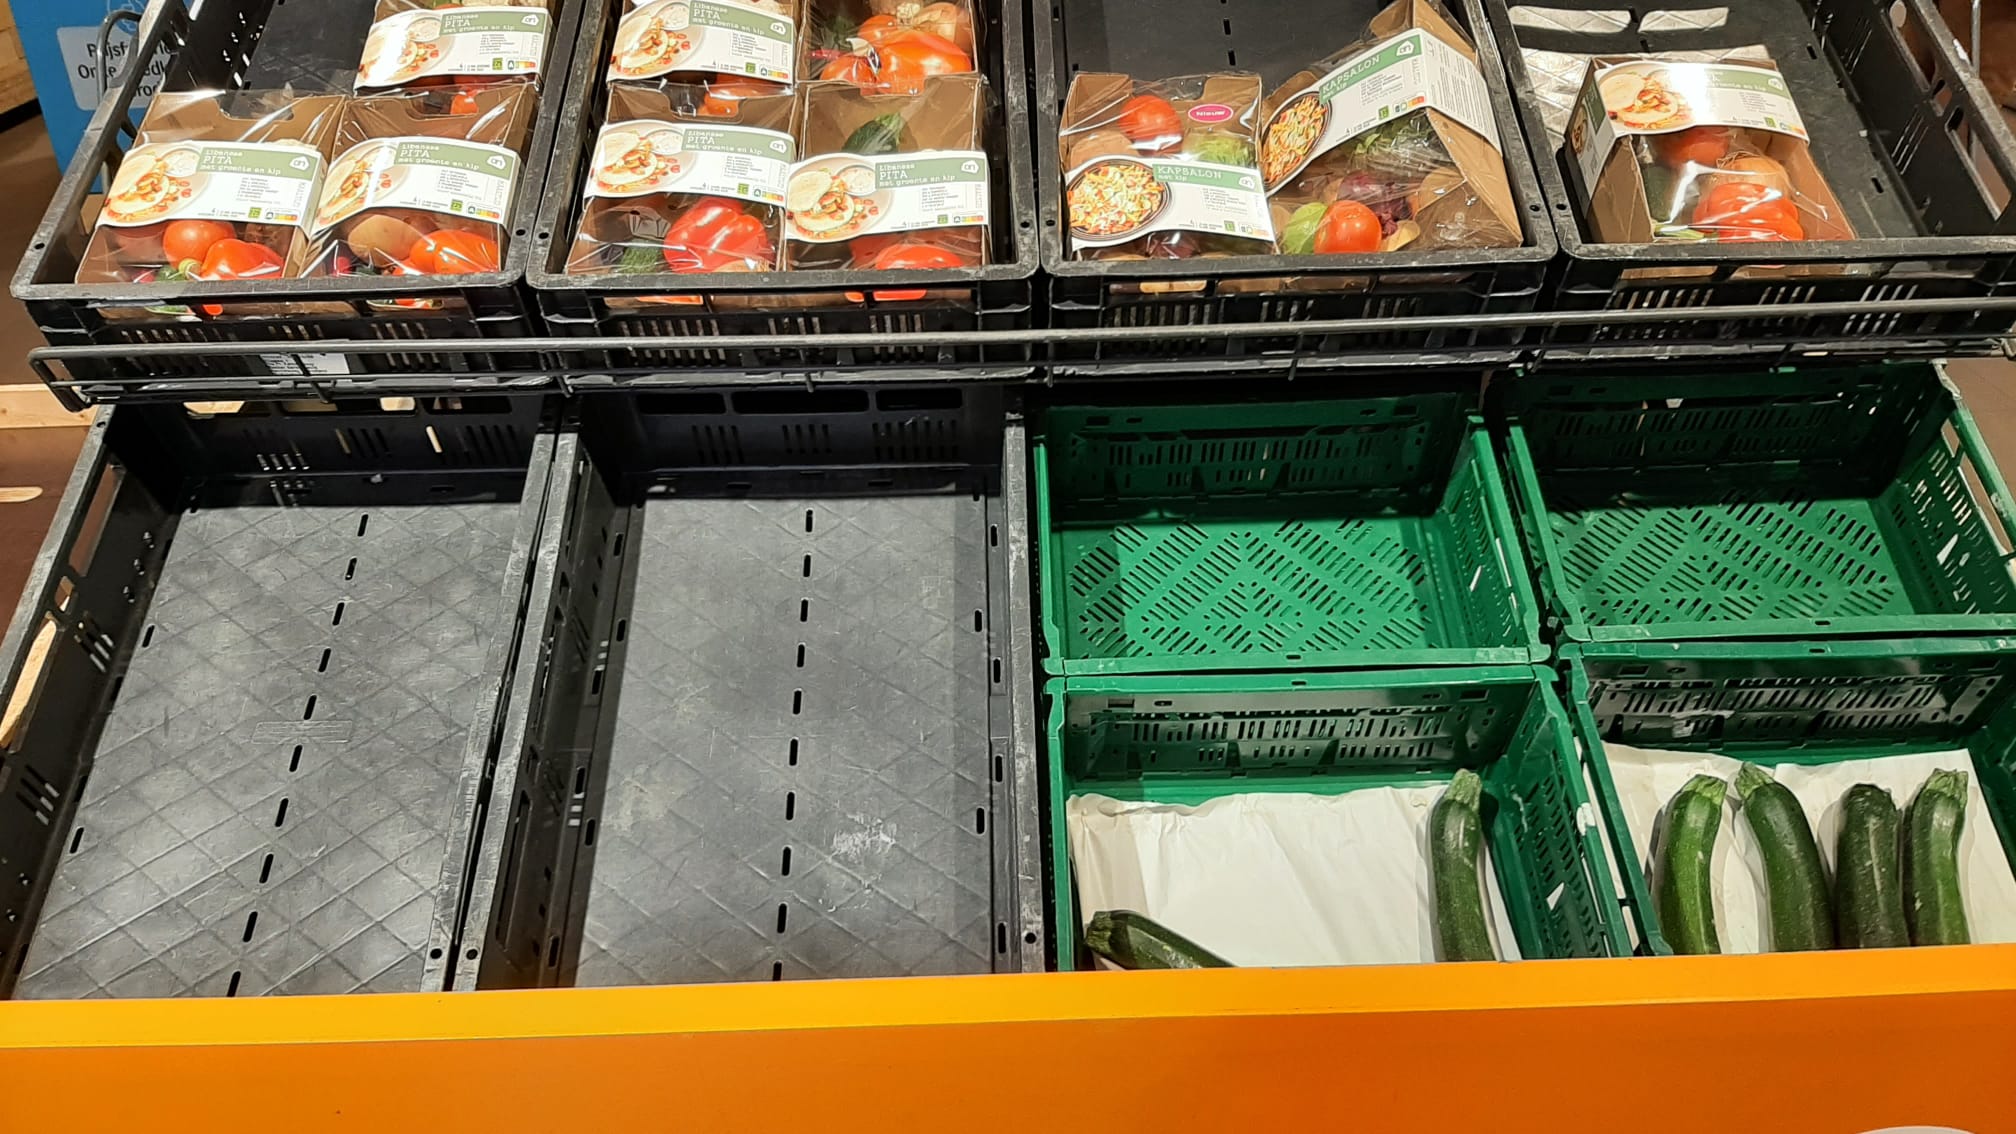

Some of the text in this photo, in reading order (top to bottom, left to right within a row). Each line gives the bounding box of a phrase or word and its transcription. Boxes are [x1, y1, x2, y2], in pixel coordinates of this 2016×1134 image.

[693, 9, 721, 20] PITA
[445, 19, 471, 28] PITA
[1322, 54, 1382, 94] KAPSALON
[687, 136, 715, 145] PITA
[400, 149, 430, 158] PITA
[202, 156, 232, 165] PITA
[880, 170, 908, 180] PITA
[1158, 166, 1222, 179] KAPSALON
